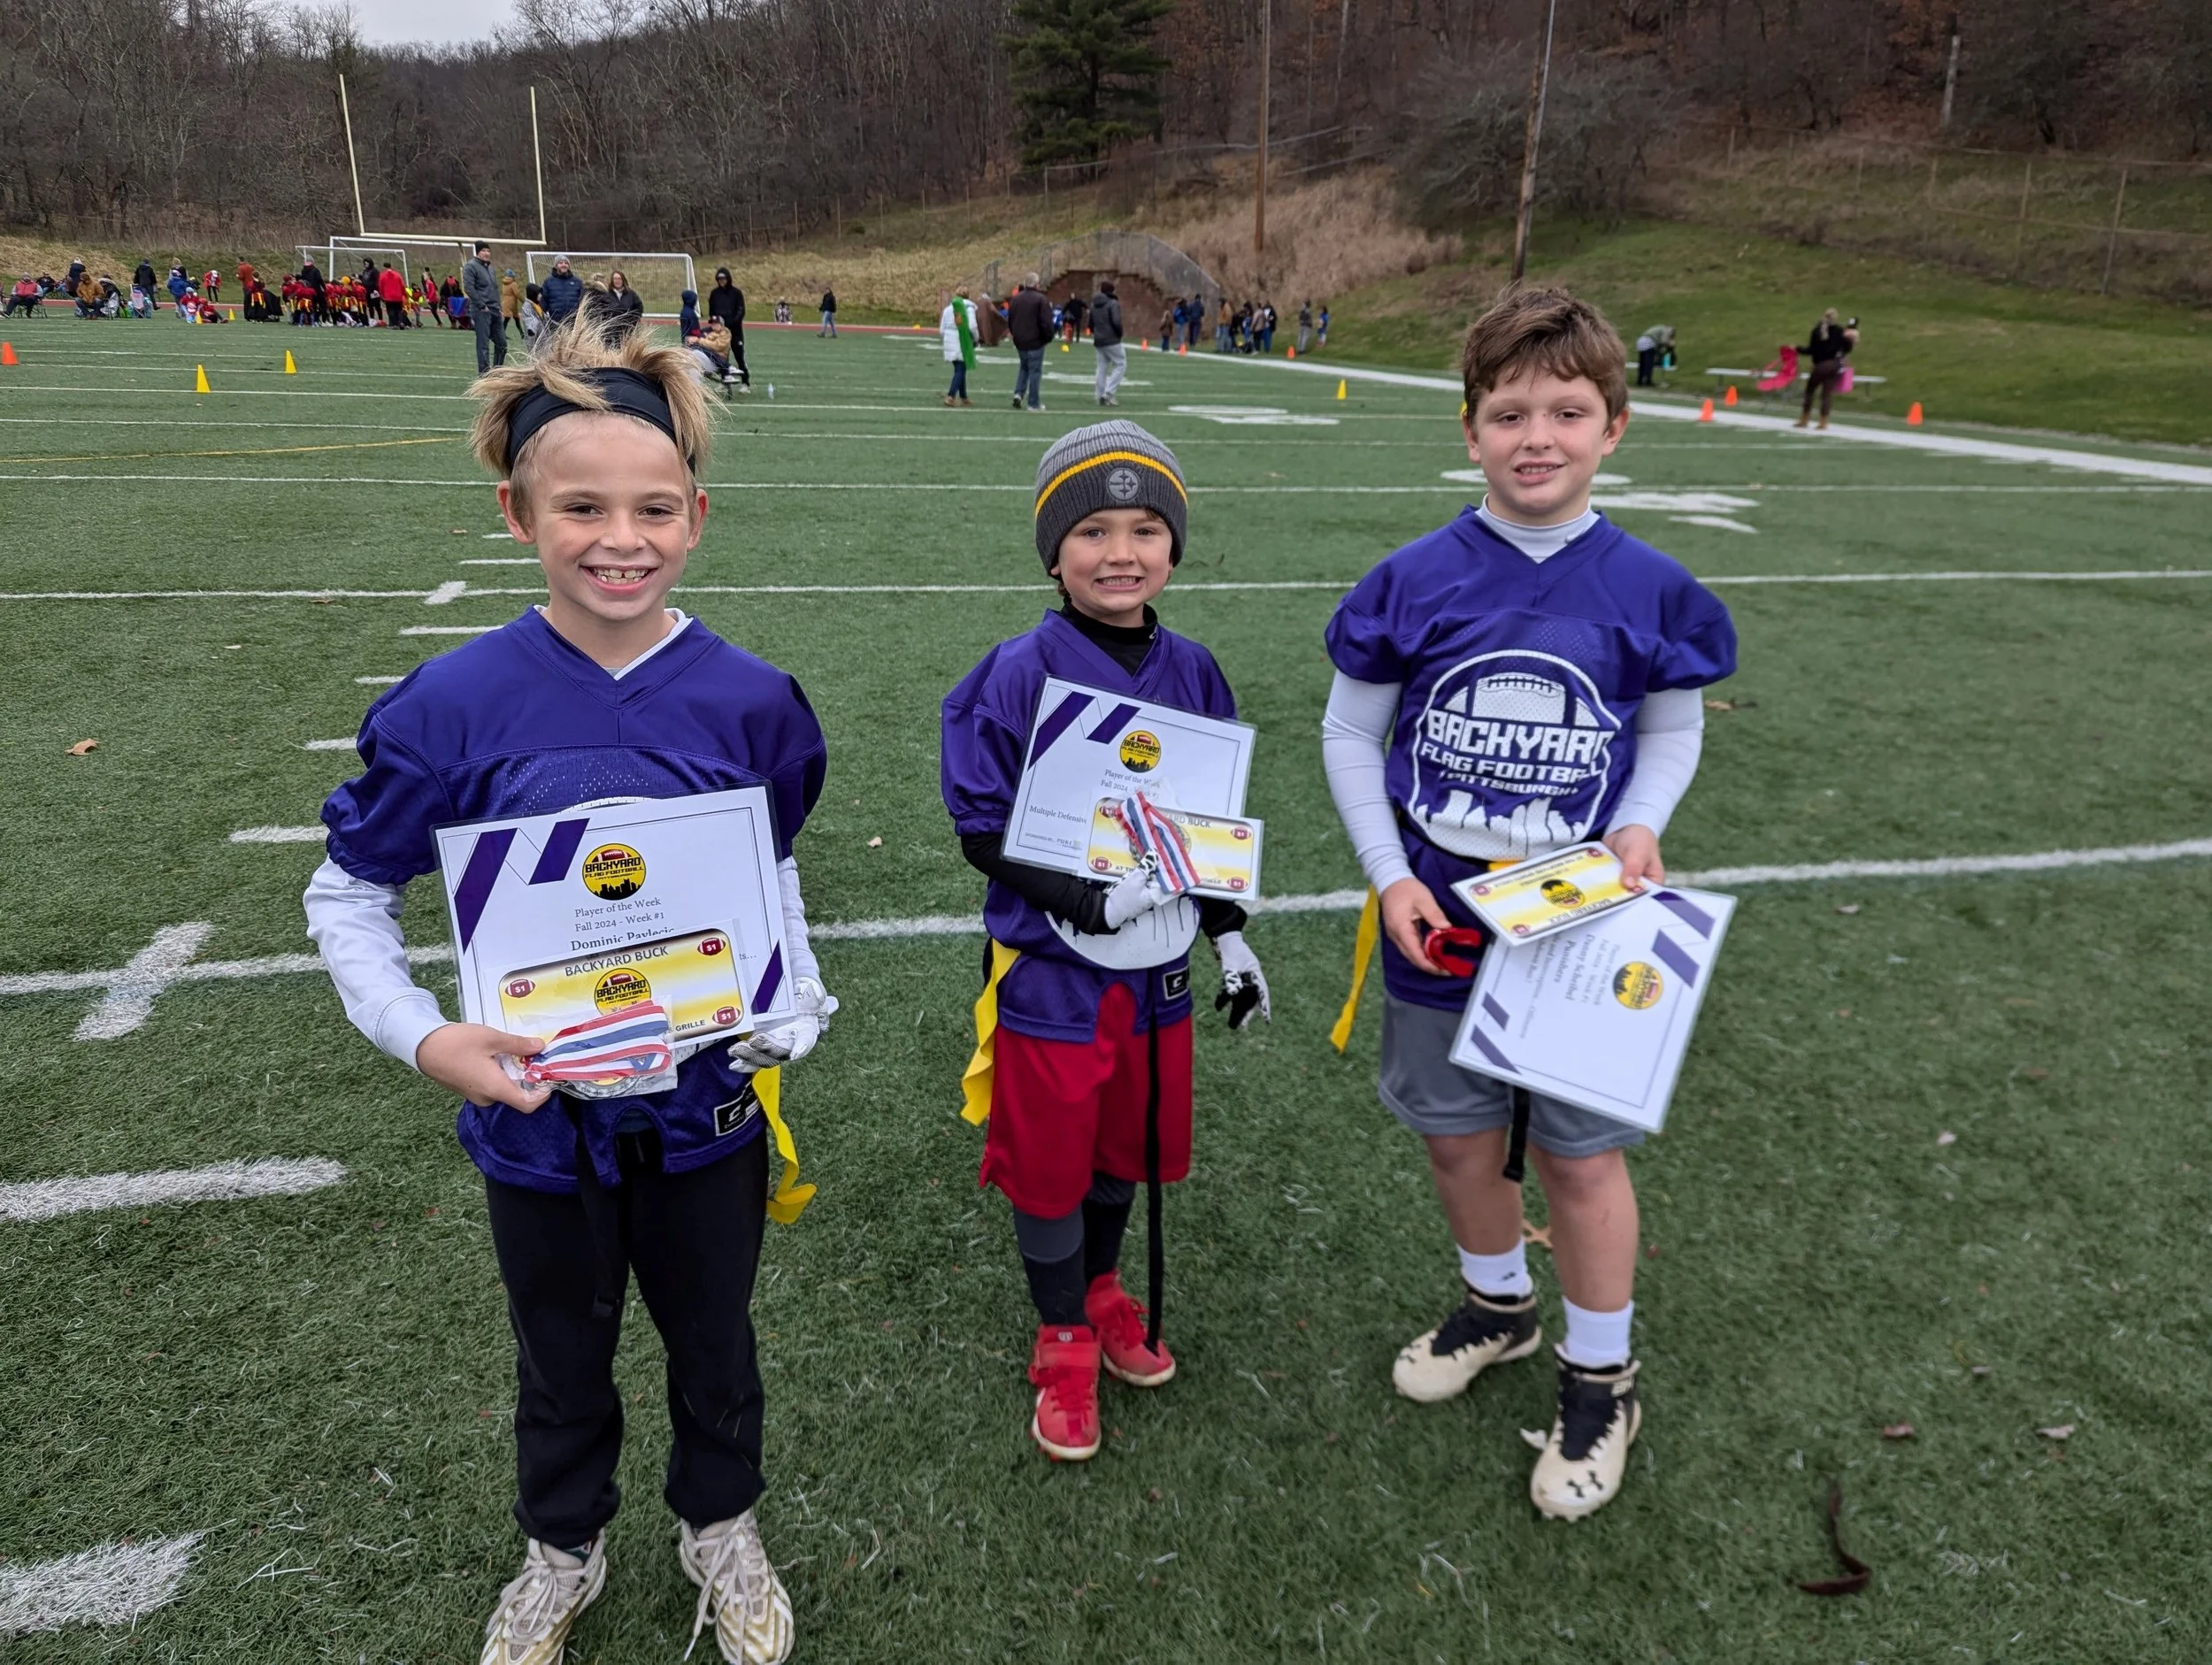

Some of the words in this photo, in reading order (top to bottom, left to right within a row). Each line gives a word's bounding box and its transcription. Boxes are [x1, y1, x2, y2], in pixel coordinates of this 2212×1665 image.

[1420, 741, 1474, 773] FLAG
[1476, 760, 1602, 784] FOOTBAL
[1029, 805, 1057, 817] Multiple
[1187, 817, 1211, 828] BUCK
[585, 856, 641, 873] BACKYARD
[574, 907, 604, 918] Player
[606, 903, 618, 913] of
[618, 902, 633, 911] the
[634, 897, 662, 909] Week
[574, 921, 592, 932] Fall
[595, 919, 617, 929] 2024
[625, 912, 652, 925] Week
[571, 934, 624, 951] Dominic
[565, 954, 632, 977] BACKYARD
[635, 945, 669, 962] BUCK
[596, 979, 647, 998] BACKYARD
[675, 1019, 706, 1032] GRILLE
